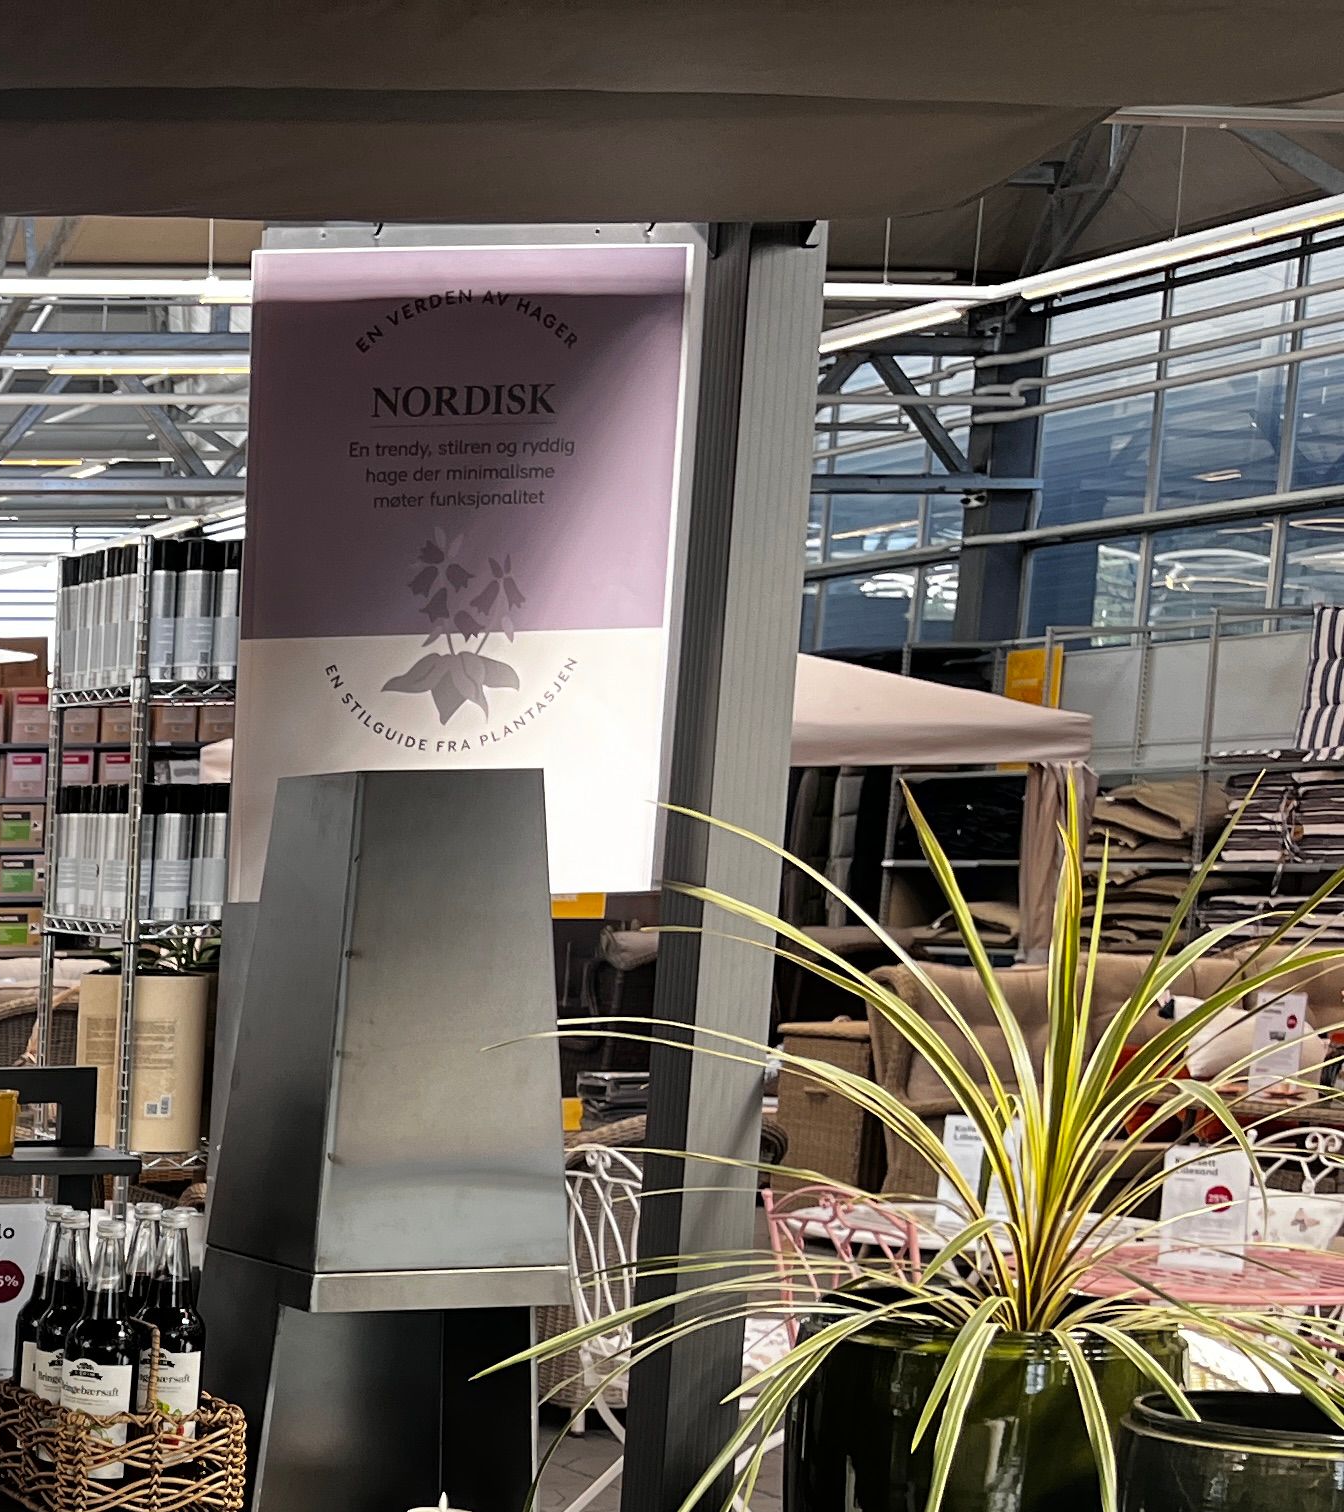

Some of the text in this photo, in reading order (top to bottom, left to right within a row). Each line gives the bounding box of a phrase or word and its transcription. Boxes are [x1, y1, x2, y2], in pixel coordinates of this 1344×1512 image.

[355, 289, 578, 353] EN VERDEN AV HAGER
[370, 383, 556, 418] NORDISK
[349, 438, 575, 459] En trendy, stilren og ryddig
[366, 463, 555, 486] hage der minimalisme
[373, 490, 545, 510] møter funksjonalitet
[325, 657, 579, 752] EN STILGUIDE FRA PLANTASJEN
